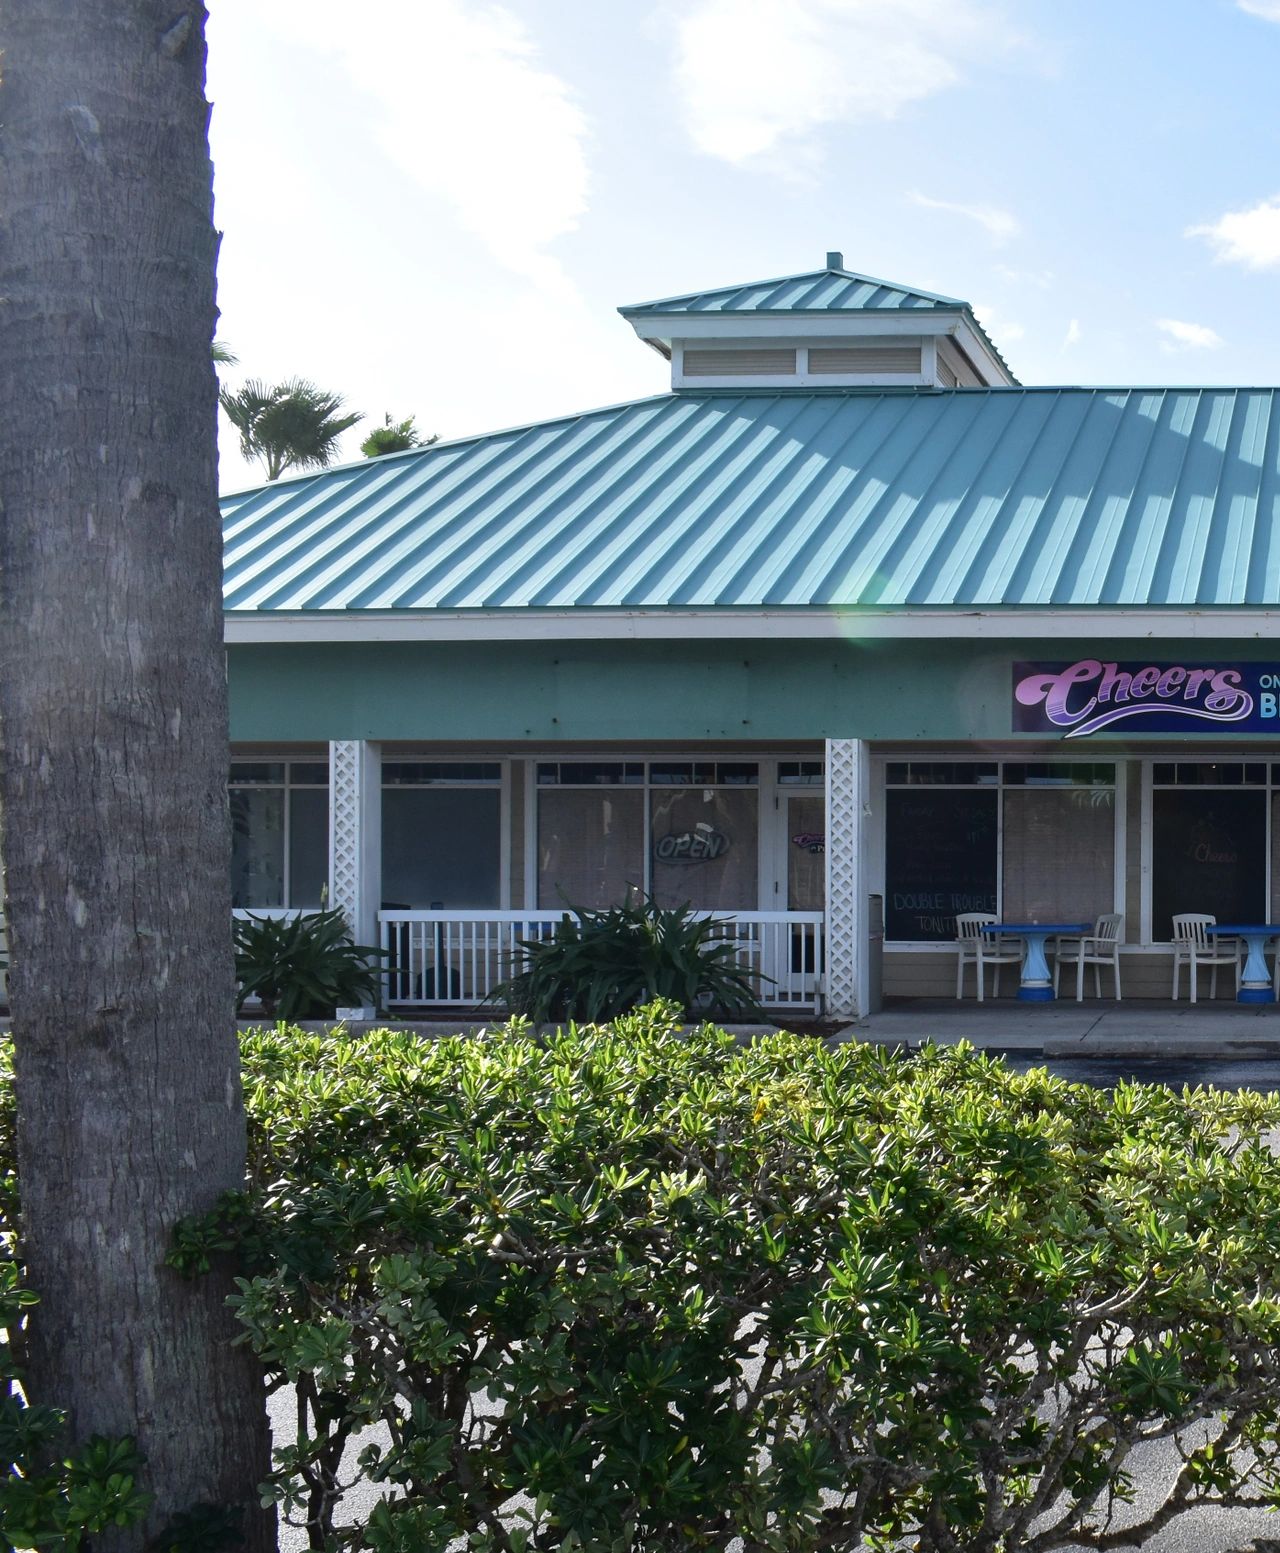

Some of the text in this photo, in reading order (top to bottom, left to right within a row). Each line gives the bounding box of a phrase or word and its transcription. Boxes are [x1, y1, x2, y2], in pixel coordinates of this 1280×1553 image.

[1015, 660, 1253, 730] Cheers
[658, 832, 721, 859] OPEN
[894, 893, 997, 912] DOUBLE TROUBLE
